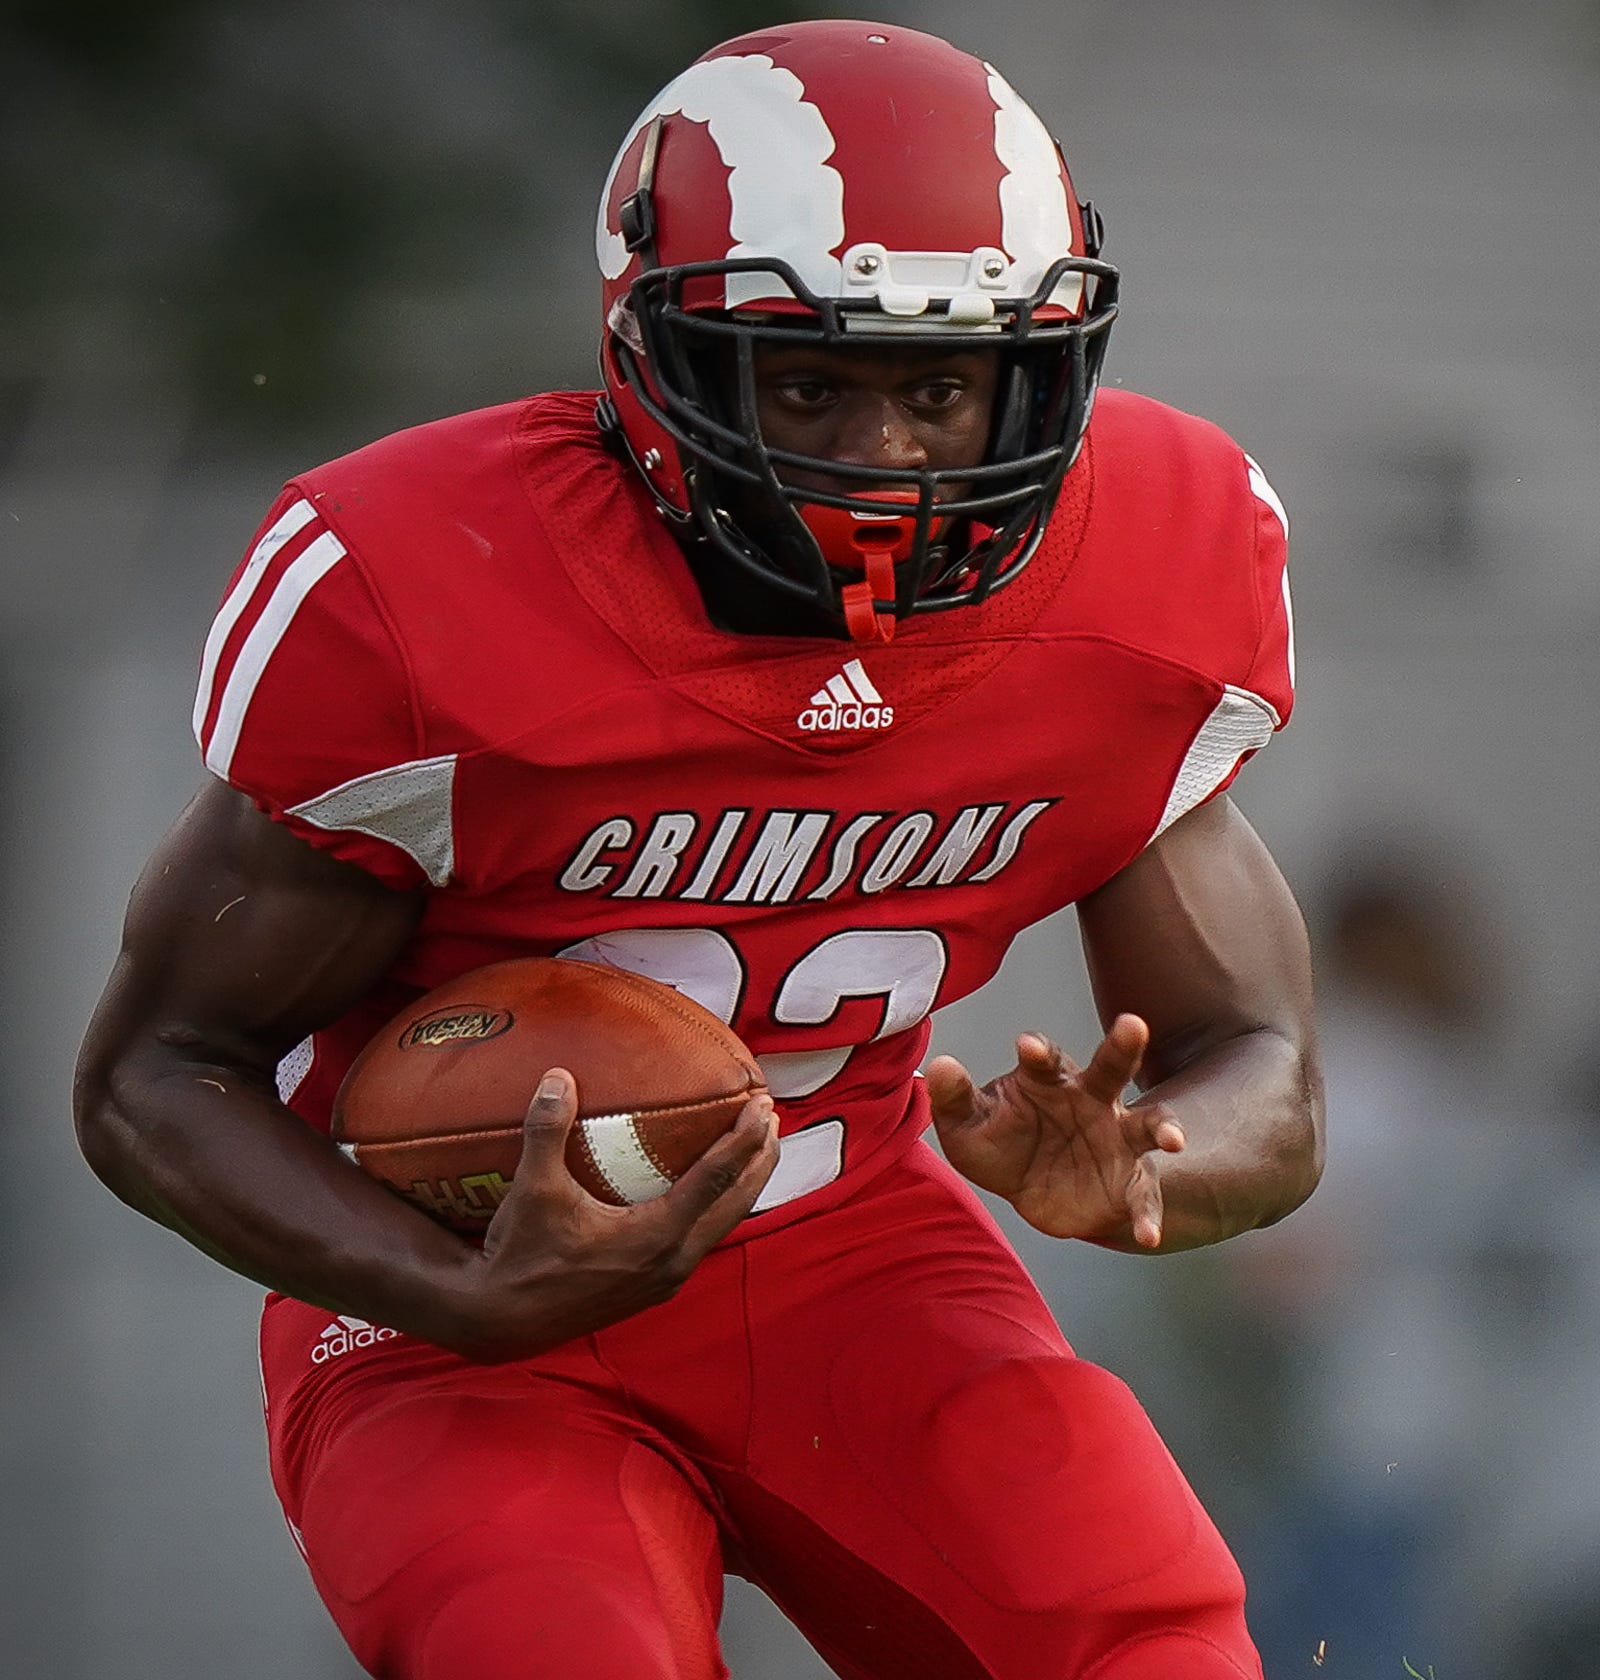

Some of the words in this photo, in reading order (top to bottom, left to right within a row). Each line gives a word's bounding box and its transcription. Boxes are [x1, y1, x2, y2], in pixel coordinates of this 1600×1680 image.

[797, 700, 895, 731] adidas
[556, 796, 1063, 905] CRIMSONS
[311, 1325, 403, 1364] adida
